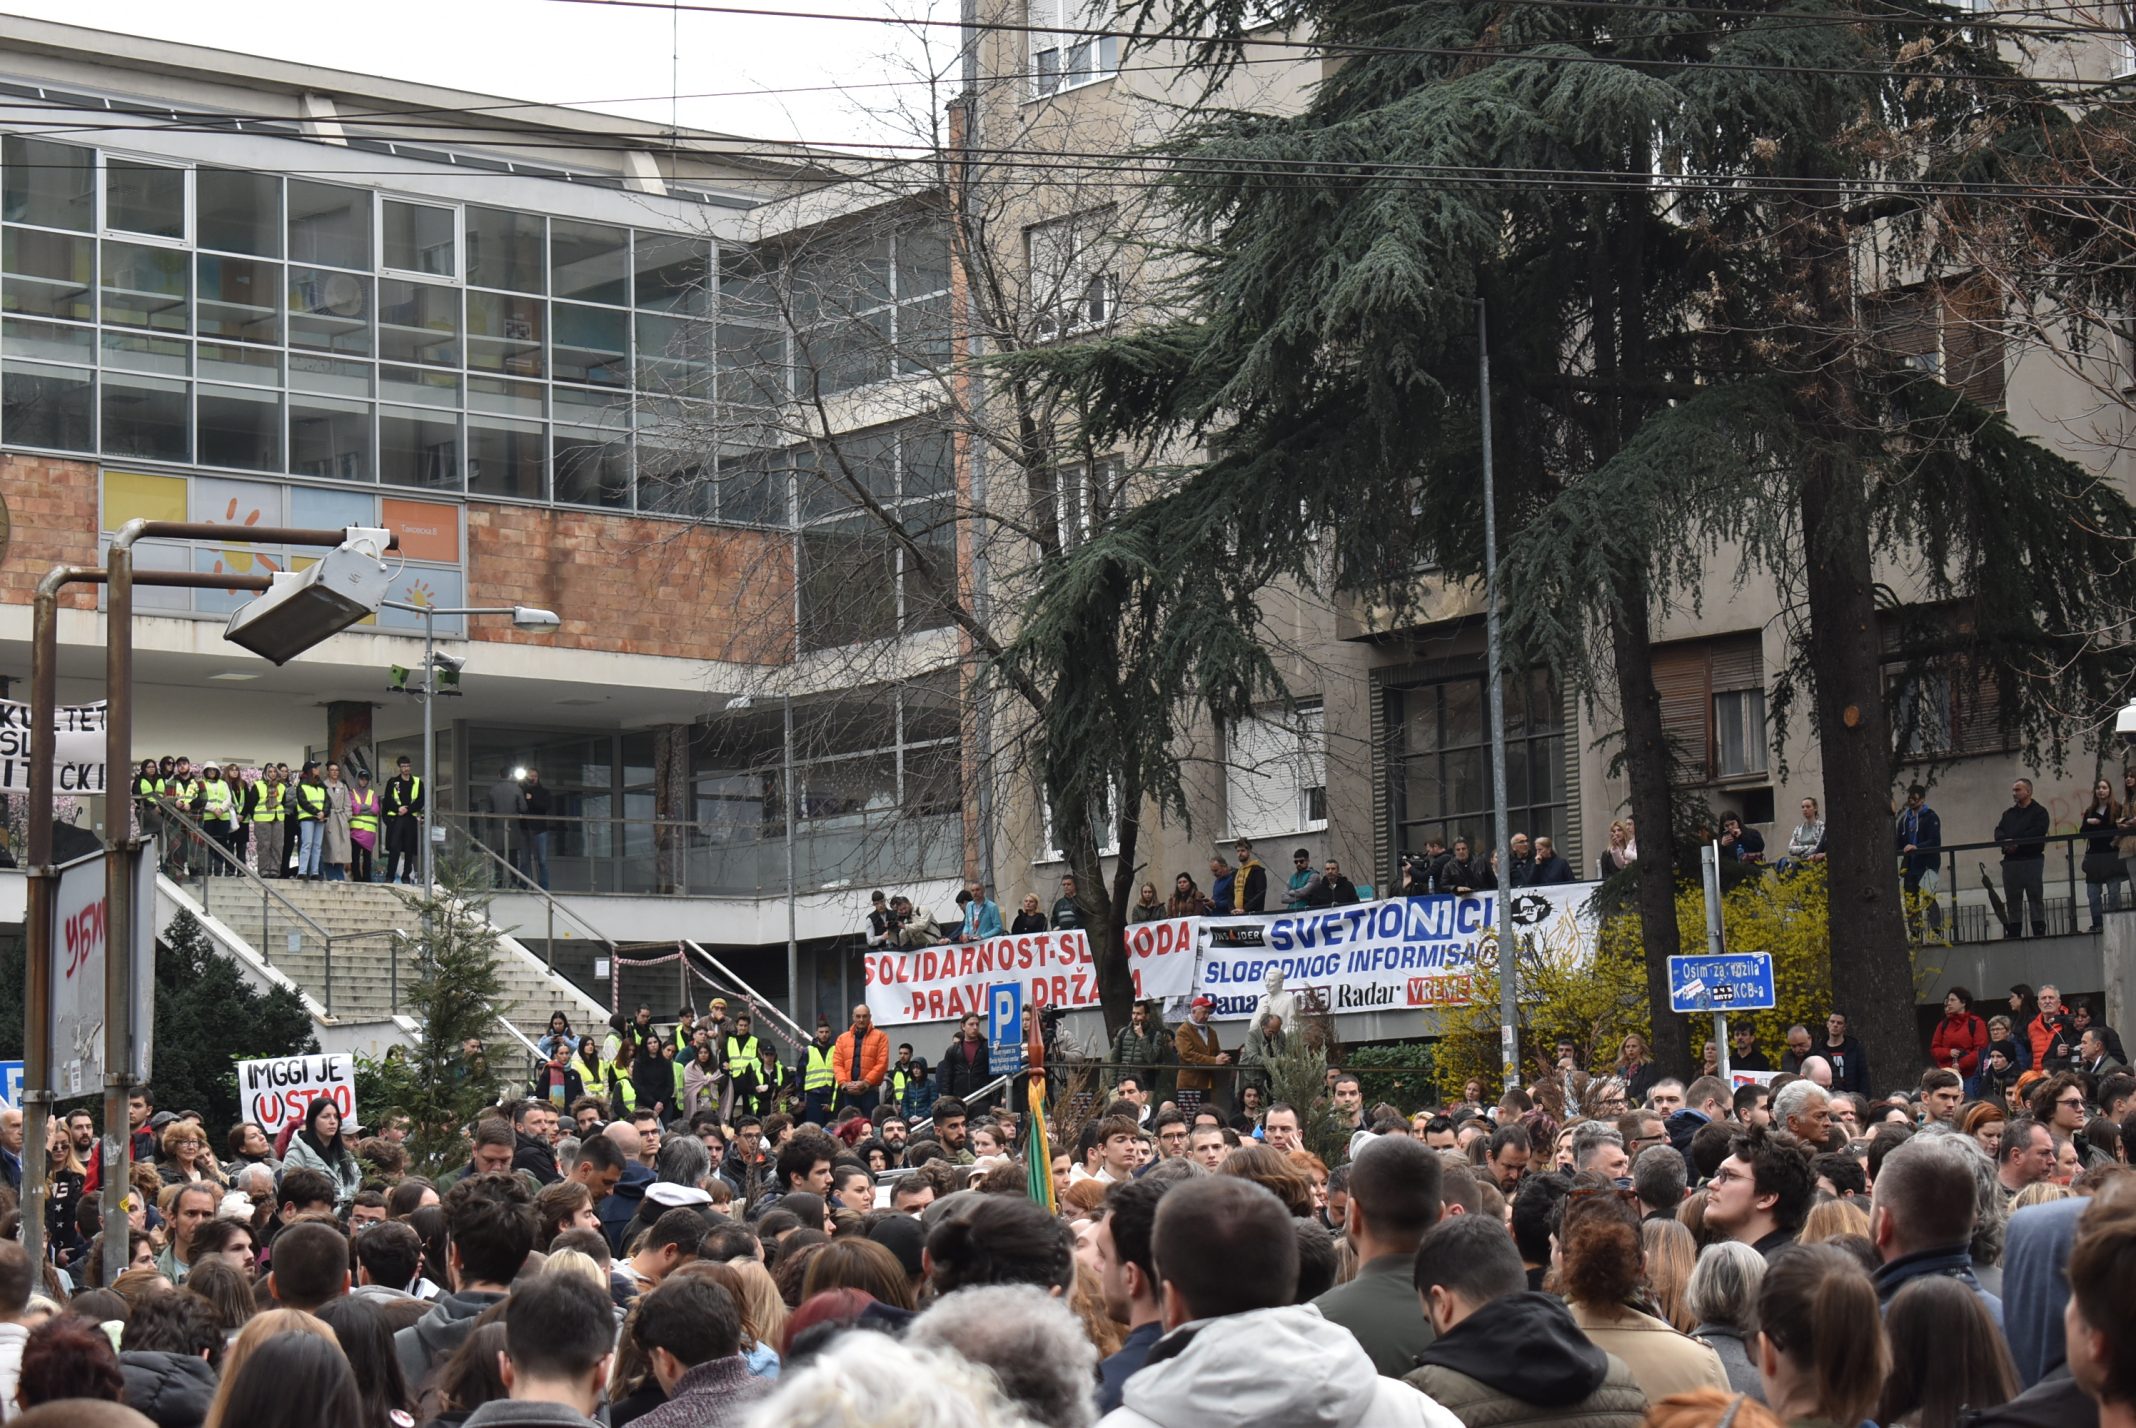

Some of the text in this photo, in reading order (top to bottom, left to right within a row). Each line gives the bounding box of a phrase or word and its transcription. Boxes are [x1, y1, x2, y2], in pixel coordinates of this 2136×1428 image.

[0, 704, 107, 732] KUTET
[3, 760, 105, 791] ITČKI
[1683, 962, 1707, 978] Osim
[1714, 964, 1724, 977] za
[1202, 992, 1267, 1015] Dana
[1338, 981, 1401, 1007] Radar
[1729, 983, 1764, 1001] KCB-a
[996, 990, 1014, 1039] P
[248, 1056, 343, 1090] IMGGI JE
